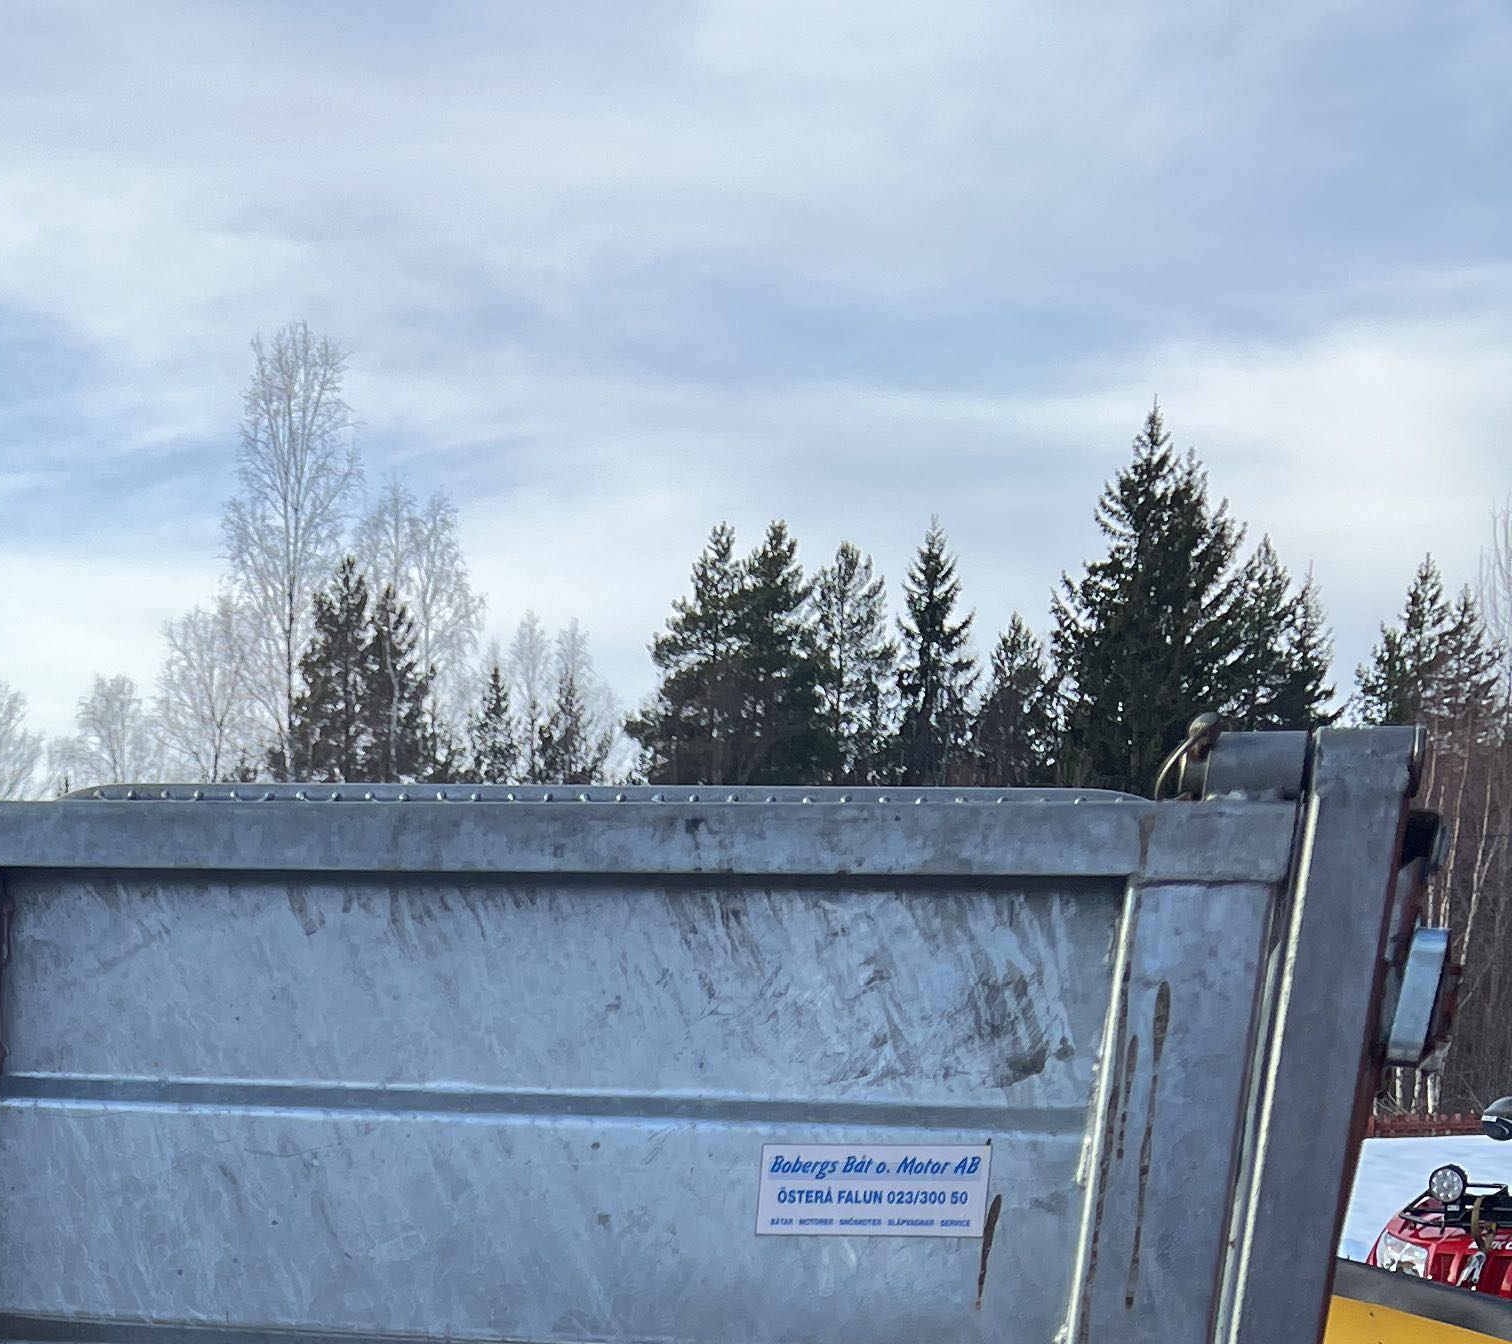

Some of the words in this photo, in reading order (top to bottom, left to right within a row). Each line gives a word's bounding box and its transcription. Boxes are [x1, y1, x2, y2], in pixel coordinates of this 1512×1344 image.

[770, 1154, 839, 1179] Bobergs
[842, 1155, 873, 1173] Båt
[875, 1161, 890, 1174] o.
[896, 1156, 950, 1175] Motor
[953, 1156, 981, 1175] AB
[777, 1186, 833, 1204] ÖSTERÅ
[837, 1190, 883, 1205] FALUN
[887, 1190, 946, 1206] 023/300
[950, 1190, 968, 1205] 50
